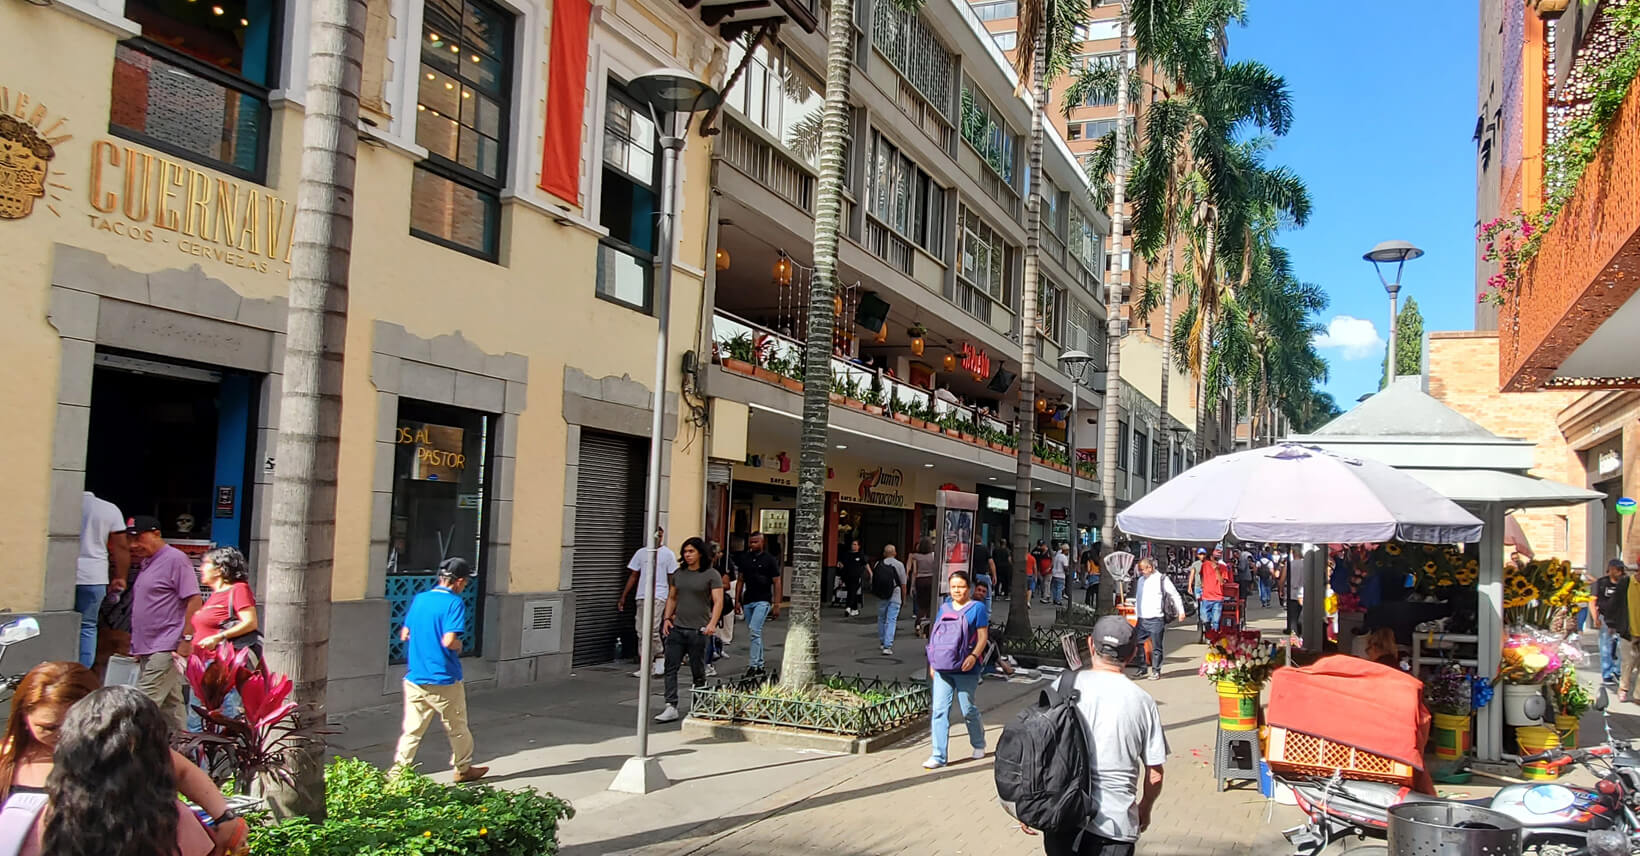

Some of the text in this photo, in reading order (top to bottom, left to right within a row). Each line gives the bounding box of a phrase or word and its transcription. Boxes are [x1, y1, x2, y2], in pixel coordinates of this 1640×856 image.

[90, 140, 297, 263] CUERNAV
[87, 213, 154, 243] TACOS
[178, 240, 267, 275] CERVEZAS
[415, 428, 432, 445] AL
[417, 447, 465, 469] PASTOR
